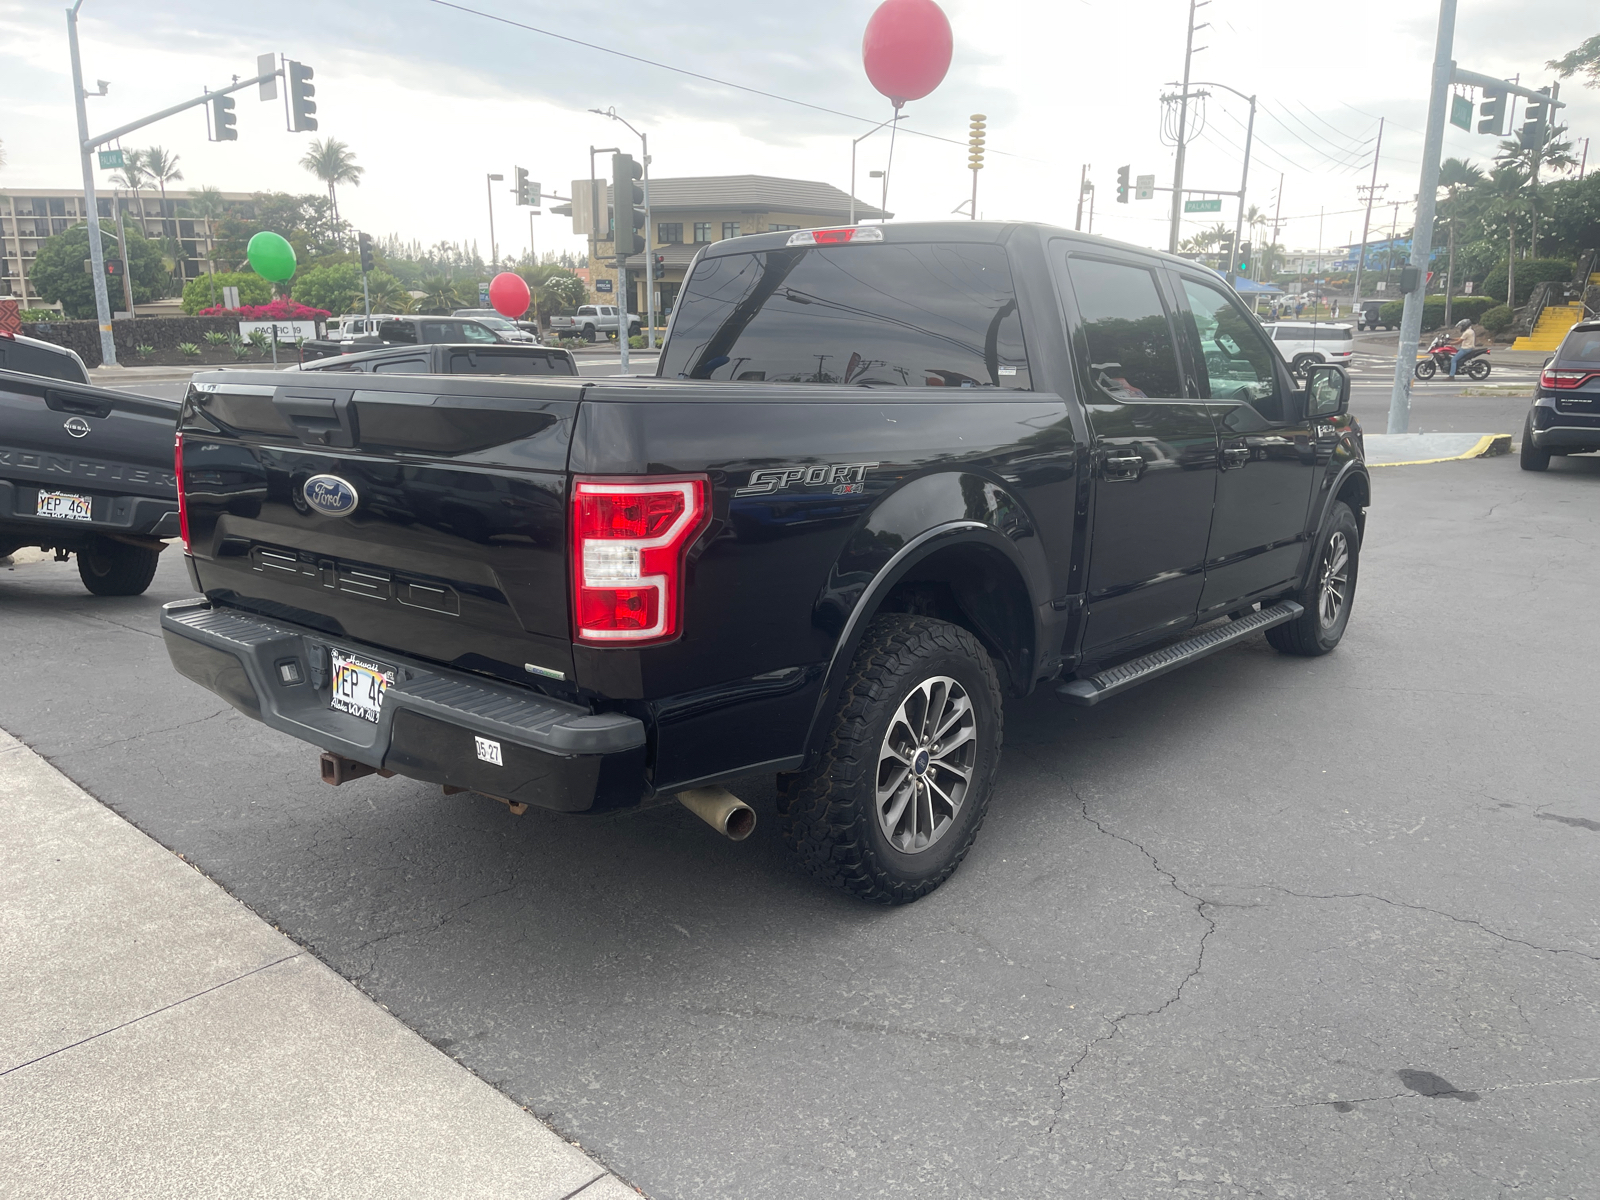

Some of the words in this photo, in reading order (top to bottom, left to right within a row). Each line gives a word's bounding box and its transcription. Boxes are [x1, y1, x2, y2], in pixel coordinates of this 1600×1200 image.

[254, 326, 289, 334] PACFIC
[63, 423, 92, 432] NISSAN
[734, 461, 880, 498] SPORT
[312, 482, 342, 507] Ford
[40, 496, 61, 511] YEP
[68, 499, 90, 515] 467
[345, 654, 379, 672] Hawaii
[333, 663, 359, 699] YEP
